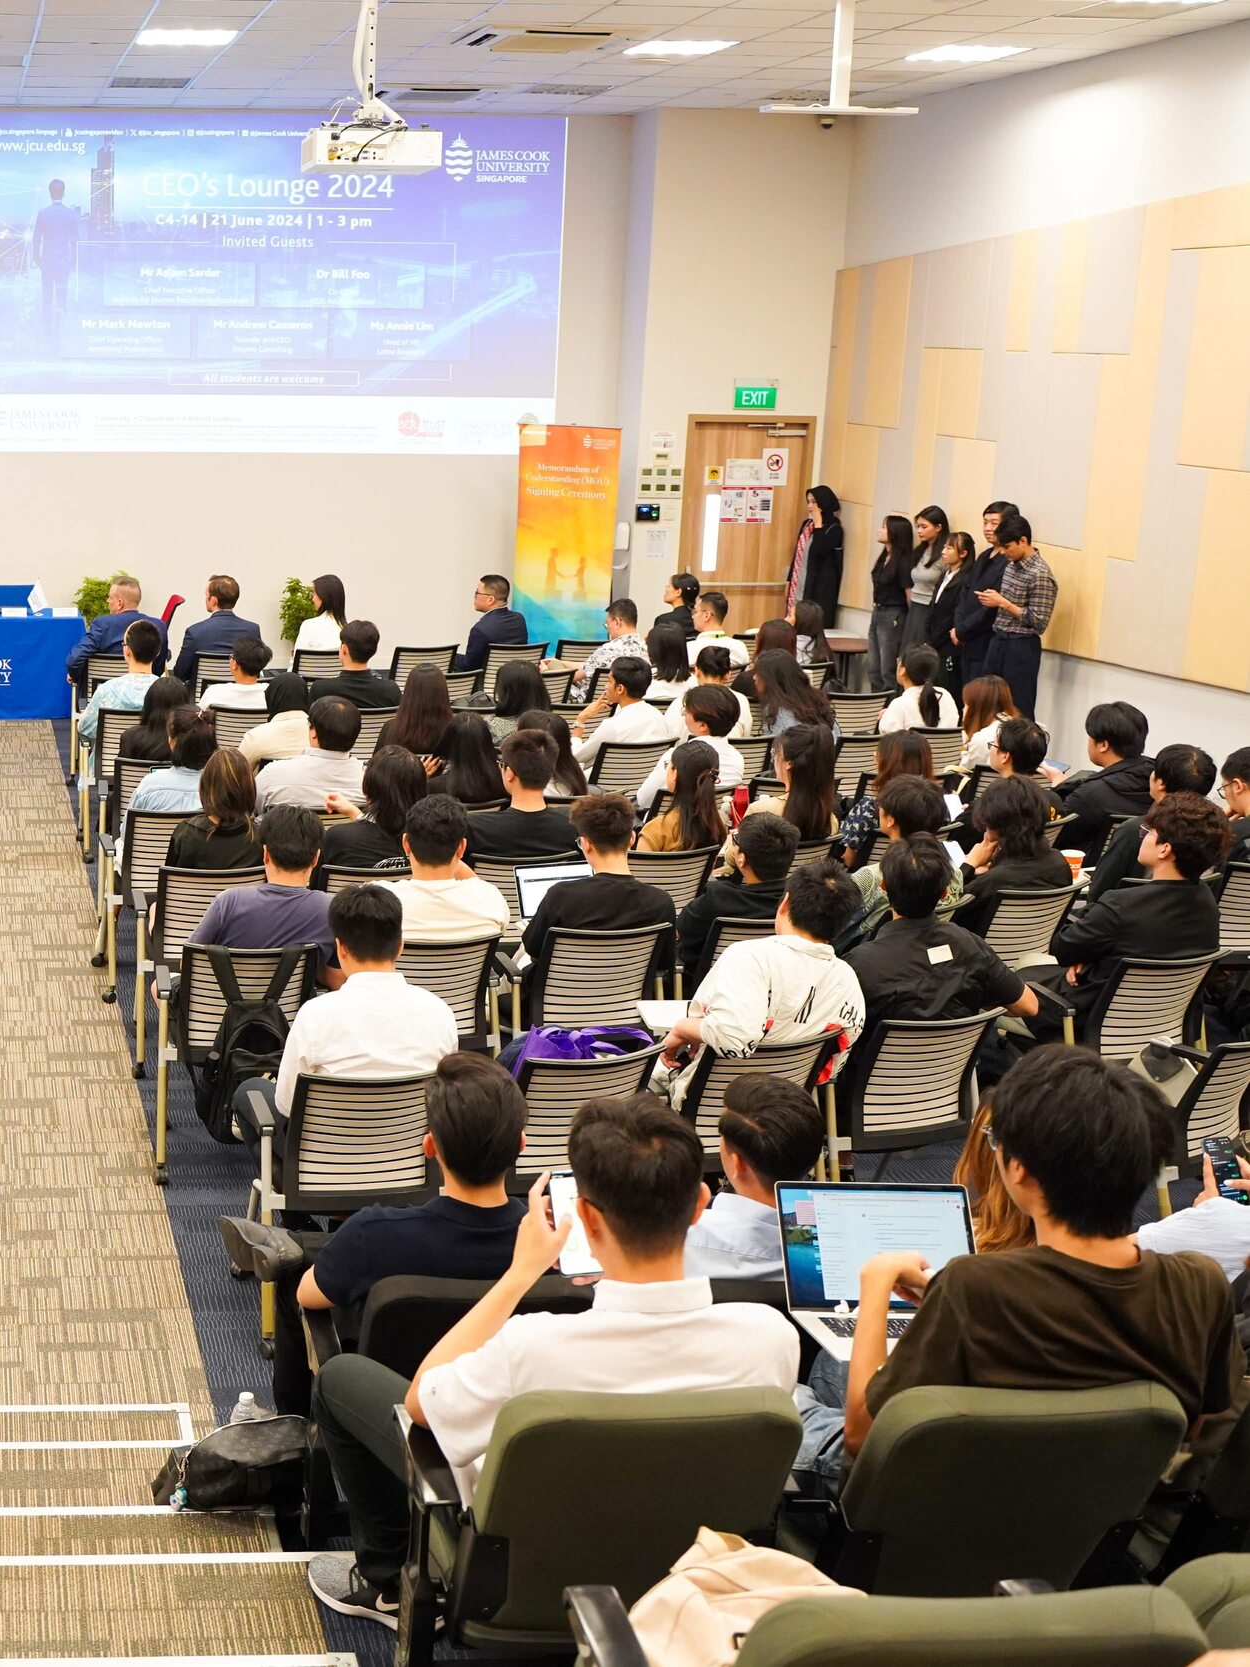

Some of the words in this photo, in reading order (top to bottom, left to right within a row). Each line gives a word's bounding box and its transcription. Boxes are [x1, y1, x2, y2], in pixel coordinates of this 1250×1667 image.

[476, 150, 513, 161] JAMES
[515, 150, 550, 161] COOK
[476, 162, 550, 173] UNIVERSITY
[476, 175, 527, 183] SINGAPORE
[142, 173, 218, 197] CEO's
[228, 173, 319, 204] Lounge
[327, 174, 395, 198] 2024
[155, 214, 198, 226] C4-14
[211, 214, 227, 226] 21
[231, 214, 263, 228] June
[267, 215, 302, 226] 2024
[317, 215, 323, 226] 1
[337, 215, 346, 227] 3
[350, 217, 372, 230] pm
[222, 235, 266, 248] Invited
[270, 235, 314, 248] Guests
[140, 268, 155, 278] Mr
[189, 268, 221, 278] Sardar
[316, 269, 330, 279] Dr
[332, 269, 349, 279] Bill
[351, 269, 370, 279] Foo
[82, 320, 97, 329] Mr
[100, 320, 126, 329] Mark
[128, 320, 171, 329] Newton
[213, 321, 227, 329] Mr
[228, 321, 267, 329] Andrew
[268, 321, 313, 329] Cameron
[370, 322, 385, 331] Ms
[386, 322, 414, 331] Annie
[416, 322, 434, 331] Lim
[203, 374, 218, 384] All
[220, 374, 262, 384] students
[264, 374, 280, 384] are
[281, 374, 325, 384] welcome
[741, 390, 769, 406] EXIT
[10, 410, 45, 420] JAMES
[47, 410, 81, 420] COOK
[10, 421, 80, 431] UNIVERSITY
[537, 463, 590, 473] Memorandum
[591, 465, 600, 474] of
[525, 473, 580, 484] Understanding
[526, 486, 559, 497] Signing
[561, 488, 607, 501] Ceremony
